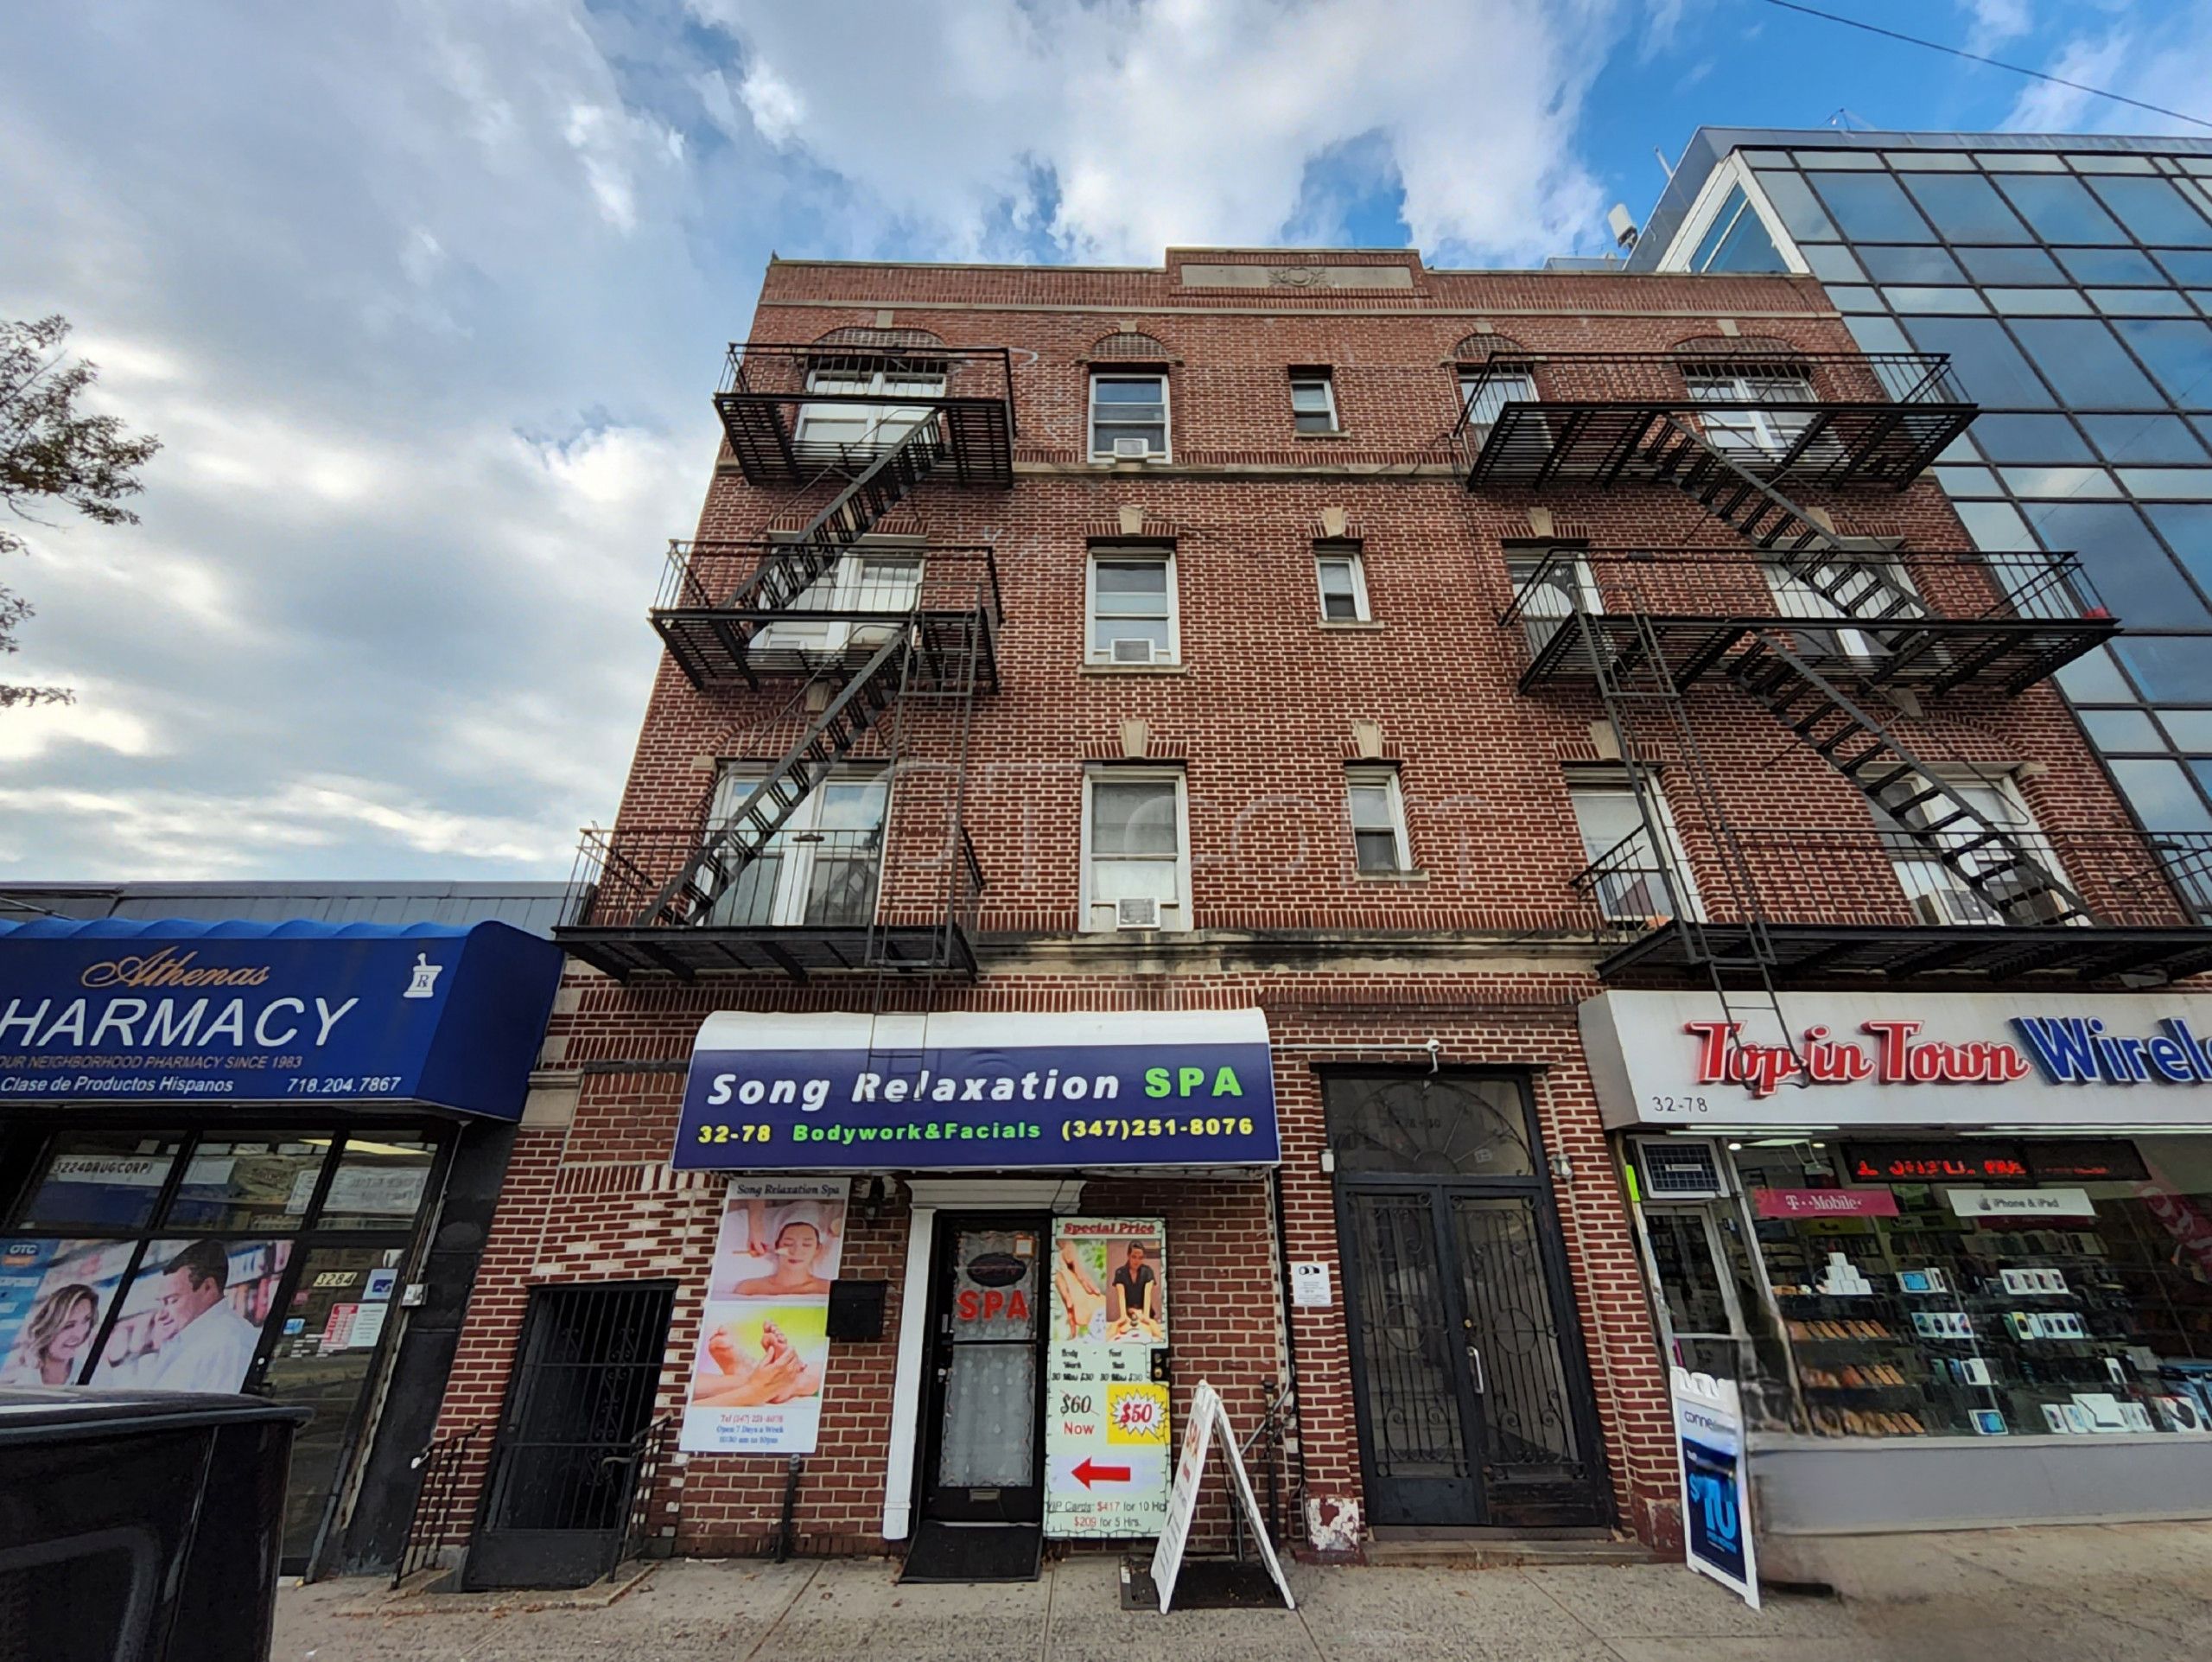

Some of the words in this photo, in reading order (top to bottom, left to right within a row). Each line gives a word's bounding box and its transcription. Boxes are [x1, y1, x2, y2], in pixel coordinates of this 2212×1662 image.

[80, 946, 270, 987] Athenas
[0, 997, 359, 1047] HARMACY
[28, 1055, 143, 1069] NEIGHBORHOOD
[144, 1055, 222, 1069] PHARMACY
[224, 1056, 269, 1069] SINCE
[271, 1055, 302, 1068] 1983
[1685, 1020, 1808, 1096] Top
[1802, 1024, 1877, 1083] in
[1858, 1020, 2031, 1084] Town
[2009, 1016, 2212, 1084] Wirel
[1, 1077, 47, 1092] Clase
[50, 1077, 70, 1091] de
[73, 1077, 156, 1092] Productos
[159, 1077, 234, 1094] Hispanos
[287, 1077, 402, 1092] 718.204.7867
[707, 1073, 830, 1112] Song
[851, 1069, 1121, 1103] Relaxation
[1143, 1067, 1243, 1098] SPA
[1651, 1096, 1708, 1113] 32-78
[697, 1124, 772, 1143] 32-78
[792, 1122, 1041, 1145] Bodywork&Facials
[1061, 1118, 1254, 1142] (347)251-8076
[737, 1184, 762, 1197] Song
[765, 1183, 819, 1194] Relaxation
[822, 1184, 840, 1197] Spa
[1065, 1222, 1116, 1235] Special
[1119, 1222, 1155, 1235] Price
[10, 1245, 37, 1254] OTC
[317, 1273, 356, 1285] 3284
[957, 1289, 1030, 1321] SPA
[1060, 1392, 1091, 1417] $60
[1121, 1402, 1152, 1425] $50
[1064, 1421, 1095, 1435] Now
[1123, 1502, 1135, 1512] for
[1140, 1502, 1150, 1511] 10
[1099, 1518, 1111, 1527] for
[1115, 1518, 1121, 1527] 5
